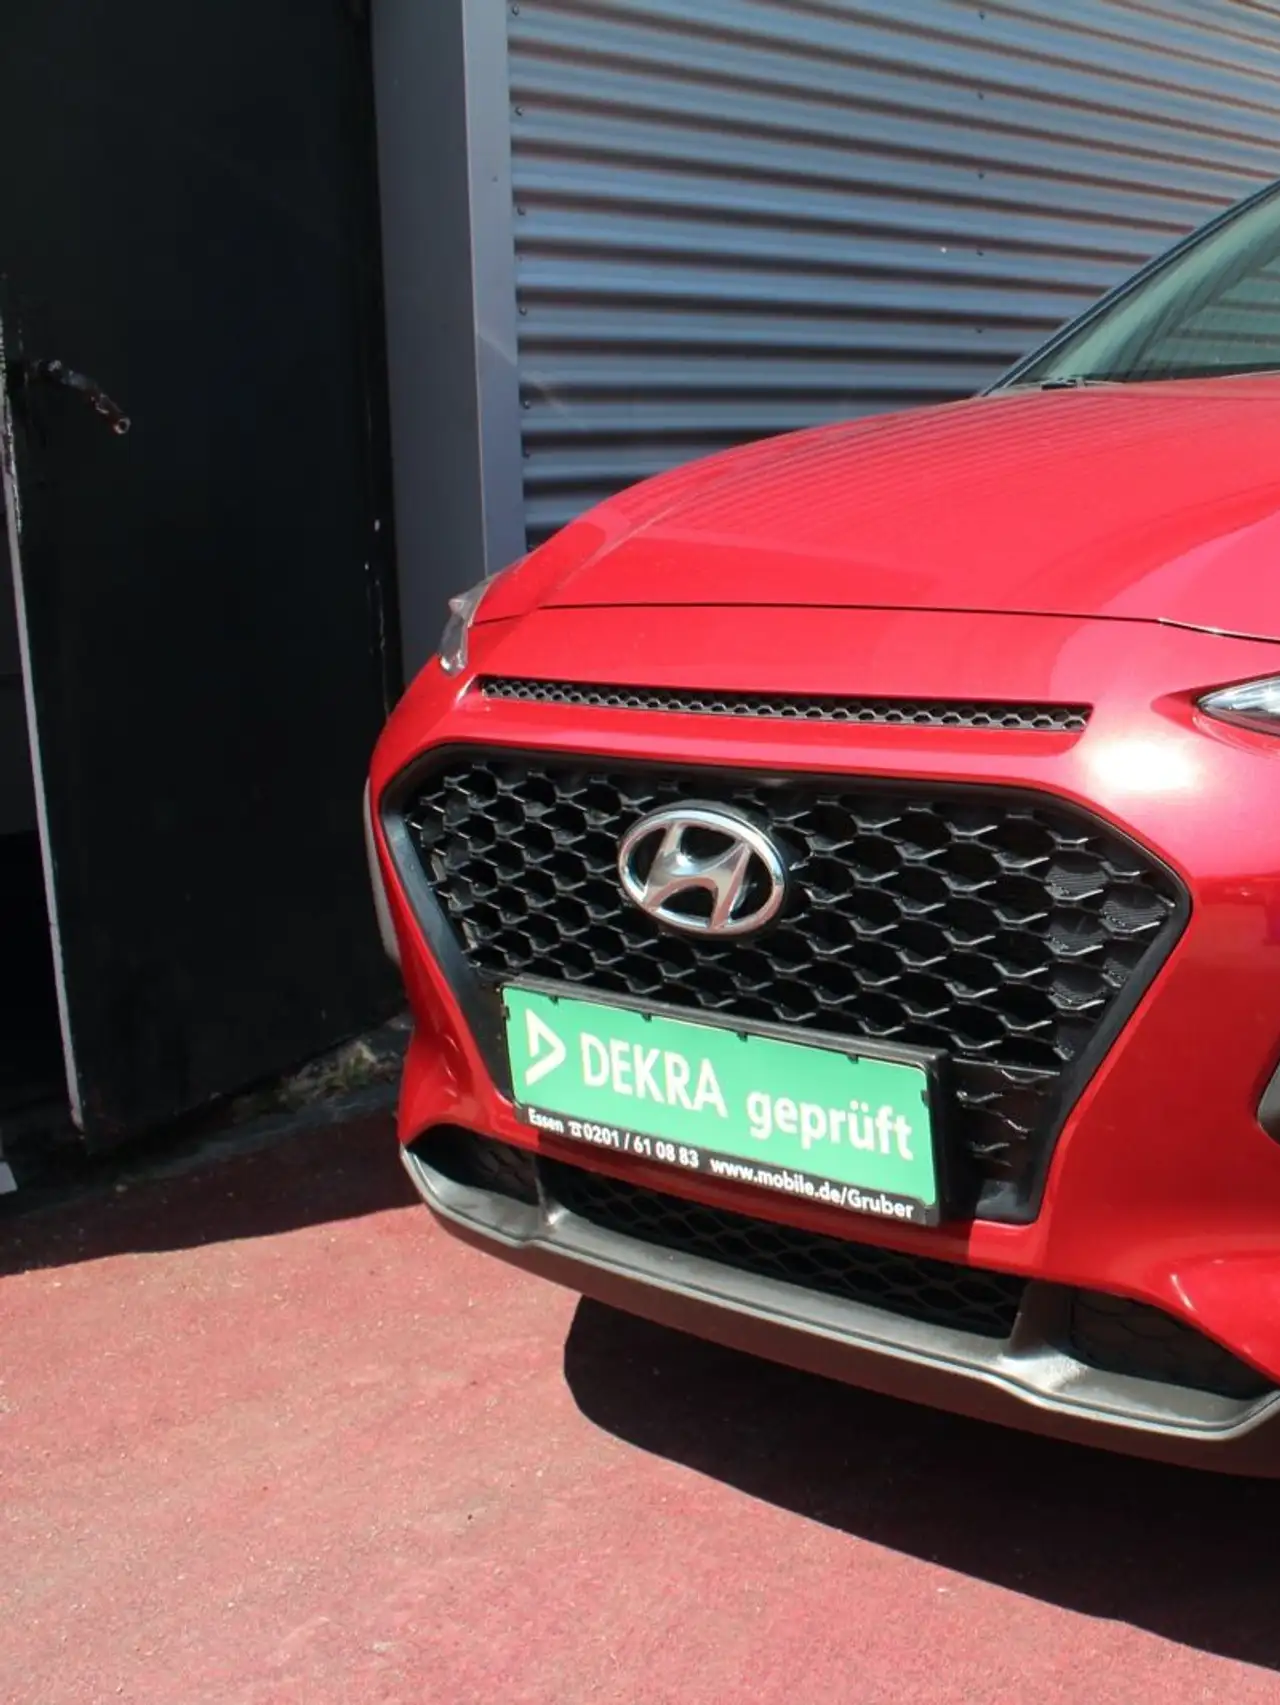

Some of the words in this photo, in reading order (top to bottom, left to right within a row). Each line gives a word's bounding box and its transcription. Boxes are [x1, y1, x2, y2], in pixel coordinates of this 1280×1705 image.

[581, 1032, 728, 1118] DEKRA
[746, 1090, 913, 1160] geprüft
[528, 1107, 564, 1134] Essen
[583, 1123, 620, 1147] 0201
[633, 1135, 651, 1155] 61
[655, 1141, 675, 1162] 08
[679, 1146, 699, 1168] 83
[710, 1157, 914, 1219] www.mobile.de/Gruber
